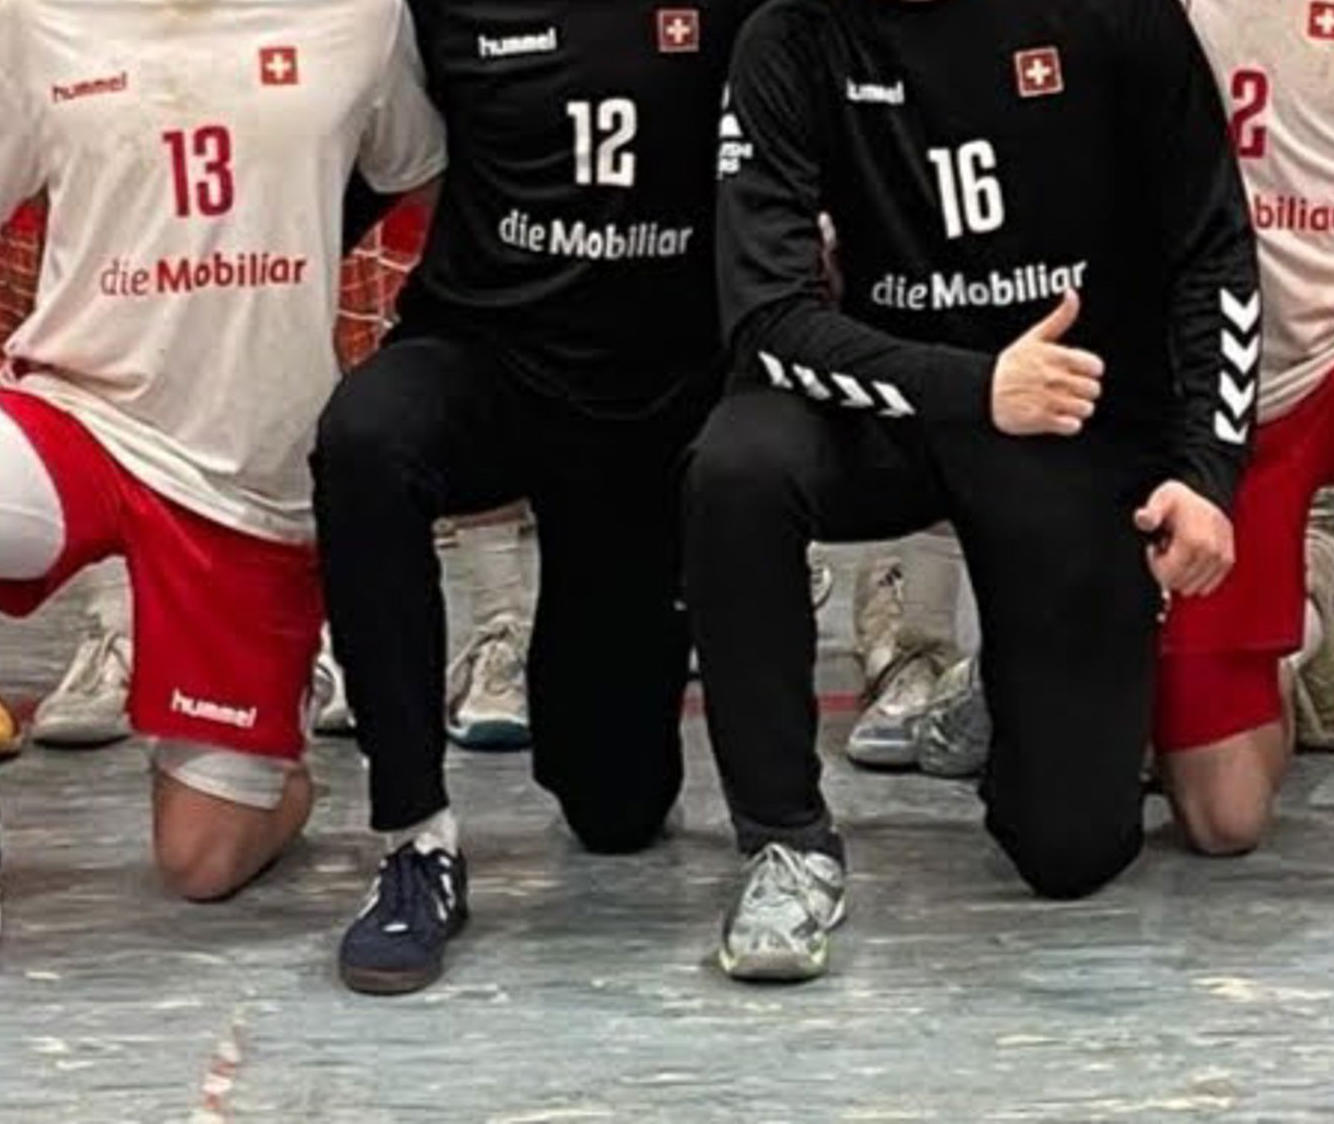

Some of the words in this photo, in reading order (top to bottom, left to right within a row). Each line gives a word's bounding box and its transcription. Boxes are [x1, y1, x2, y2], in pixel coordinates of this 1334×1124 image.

[478, 27, 558, 58] hummel
[567, 98, 637, 187] 12
[1231, 69, 1269, 158] 2
[162, 125, 234, 217] 13
[928, 139, 1005, 239] 16
